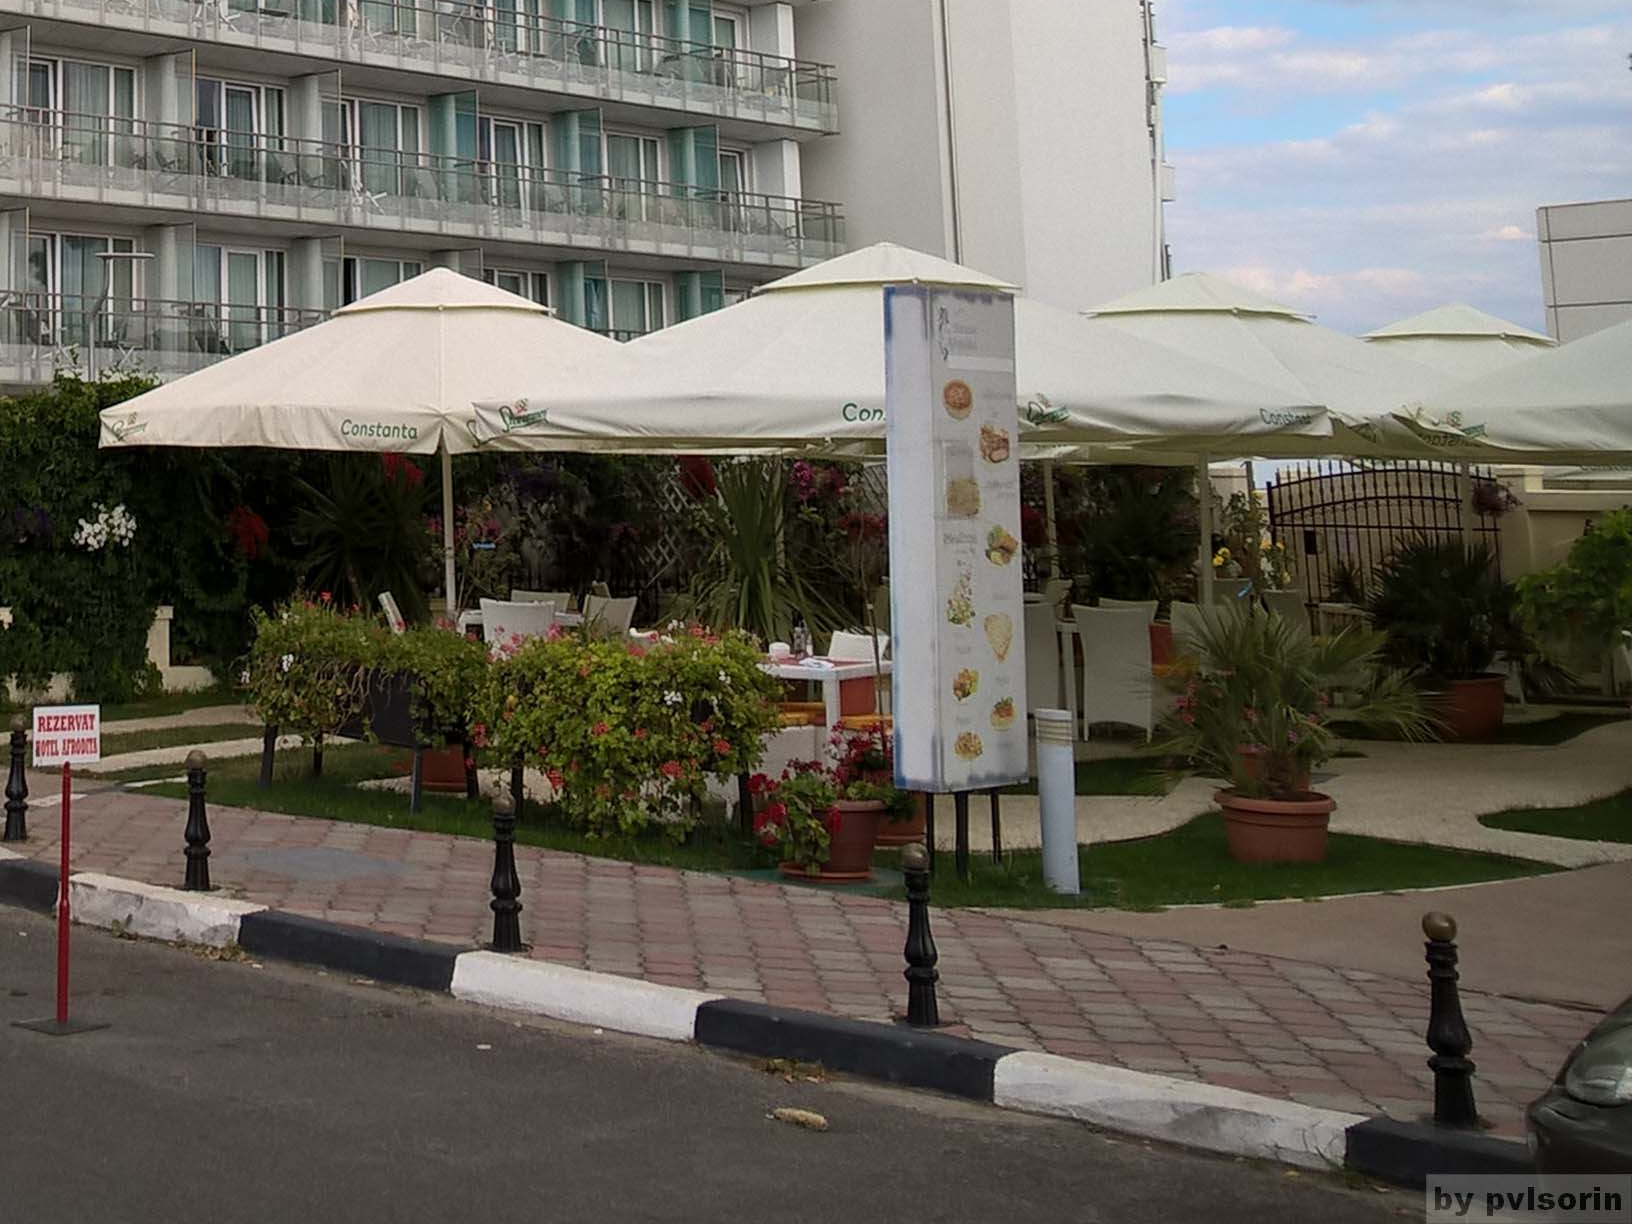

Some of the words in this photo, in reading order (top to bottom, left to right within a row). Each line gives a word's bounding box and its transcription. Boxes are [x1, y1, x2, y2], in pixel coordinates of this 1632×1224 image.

[842, 402, 887, 422] Con
[340, 419, 418, 440] Constanta
[37, 714, 96, 733] REZERVAT
[35, 739, 60, 757] HOTEL
